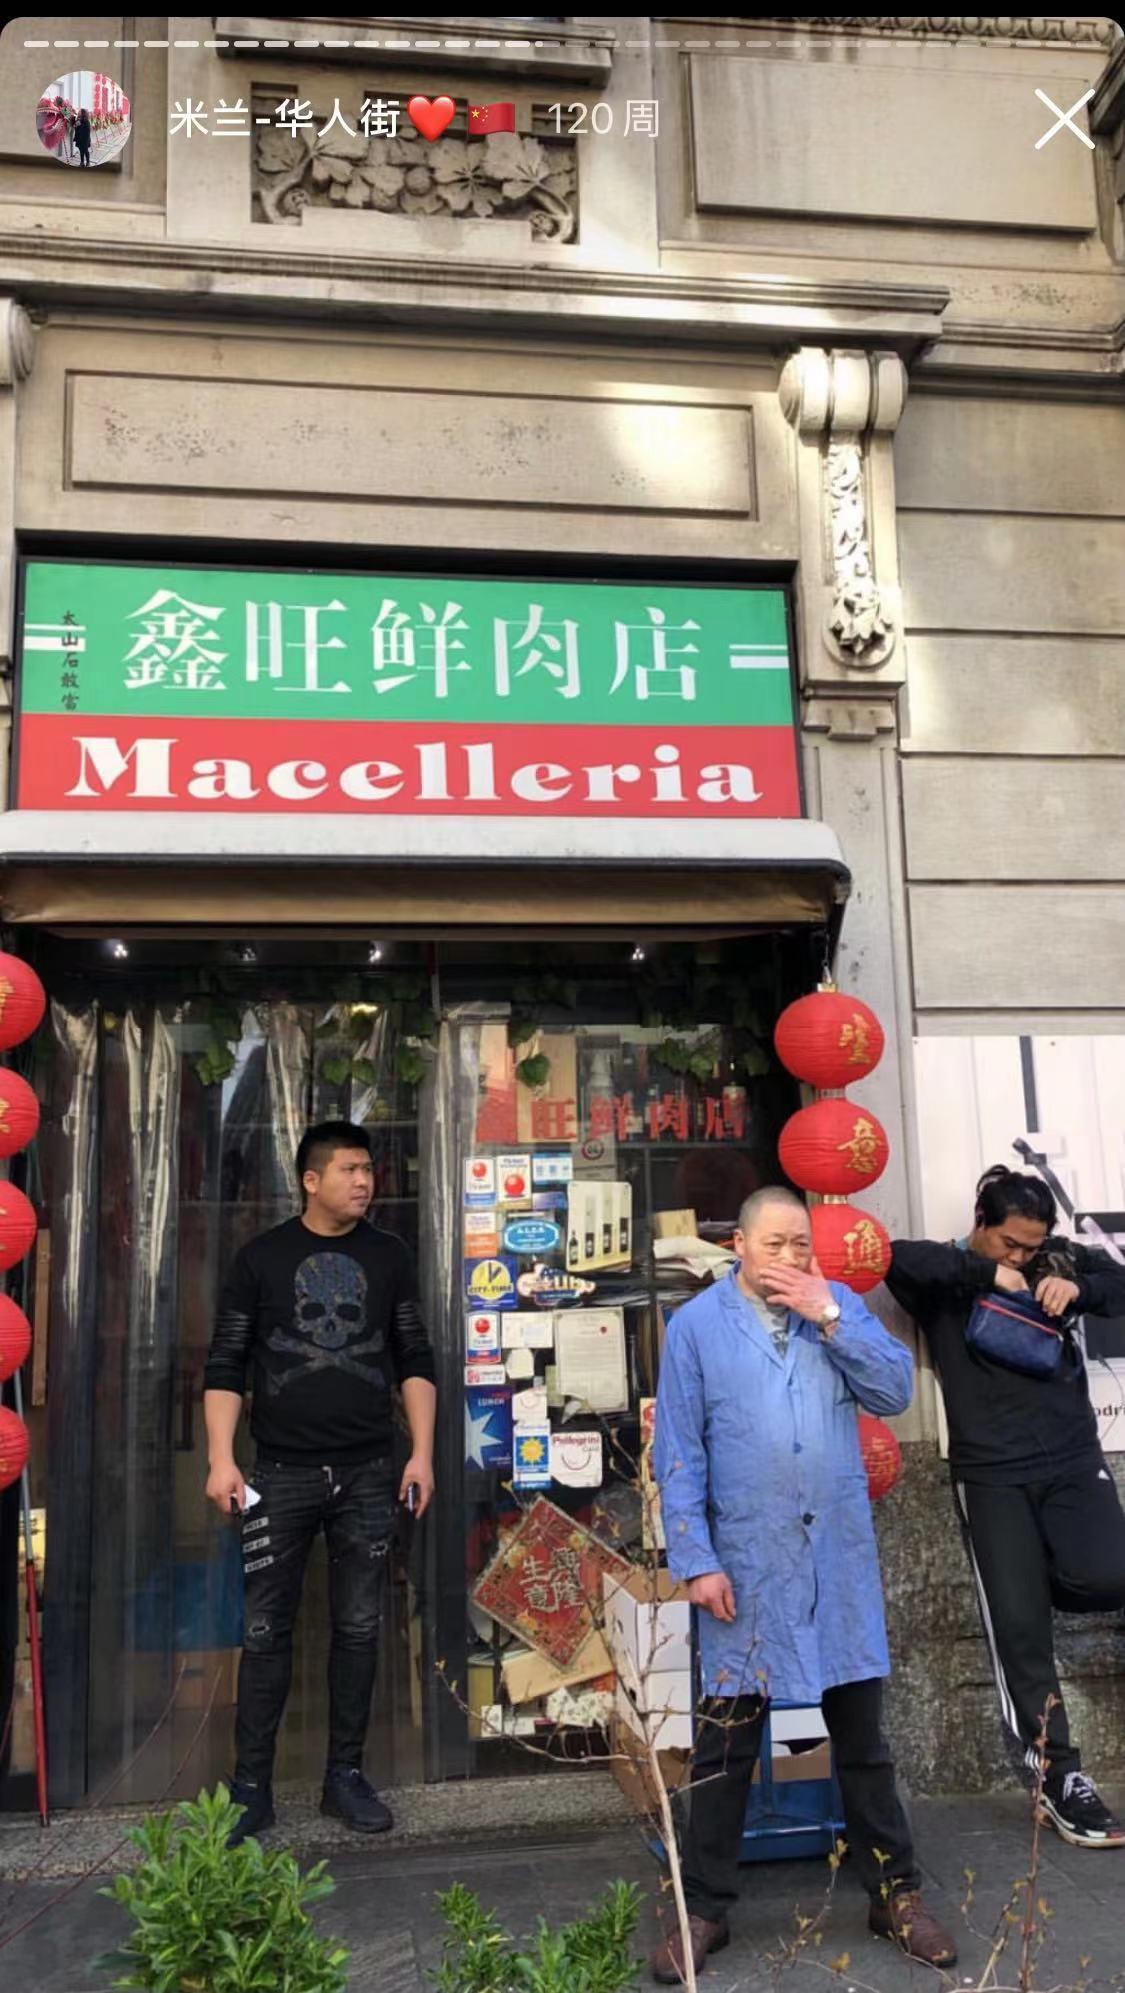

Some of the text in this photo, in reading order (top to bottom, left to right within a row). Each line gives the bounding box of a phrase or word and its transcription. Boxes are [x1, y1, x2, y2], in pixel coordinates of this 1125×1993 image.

[124, 588, 702, 702] 鑫旺鲜肉店
[64, 735, 763, 803] Macelleria
